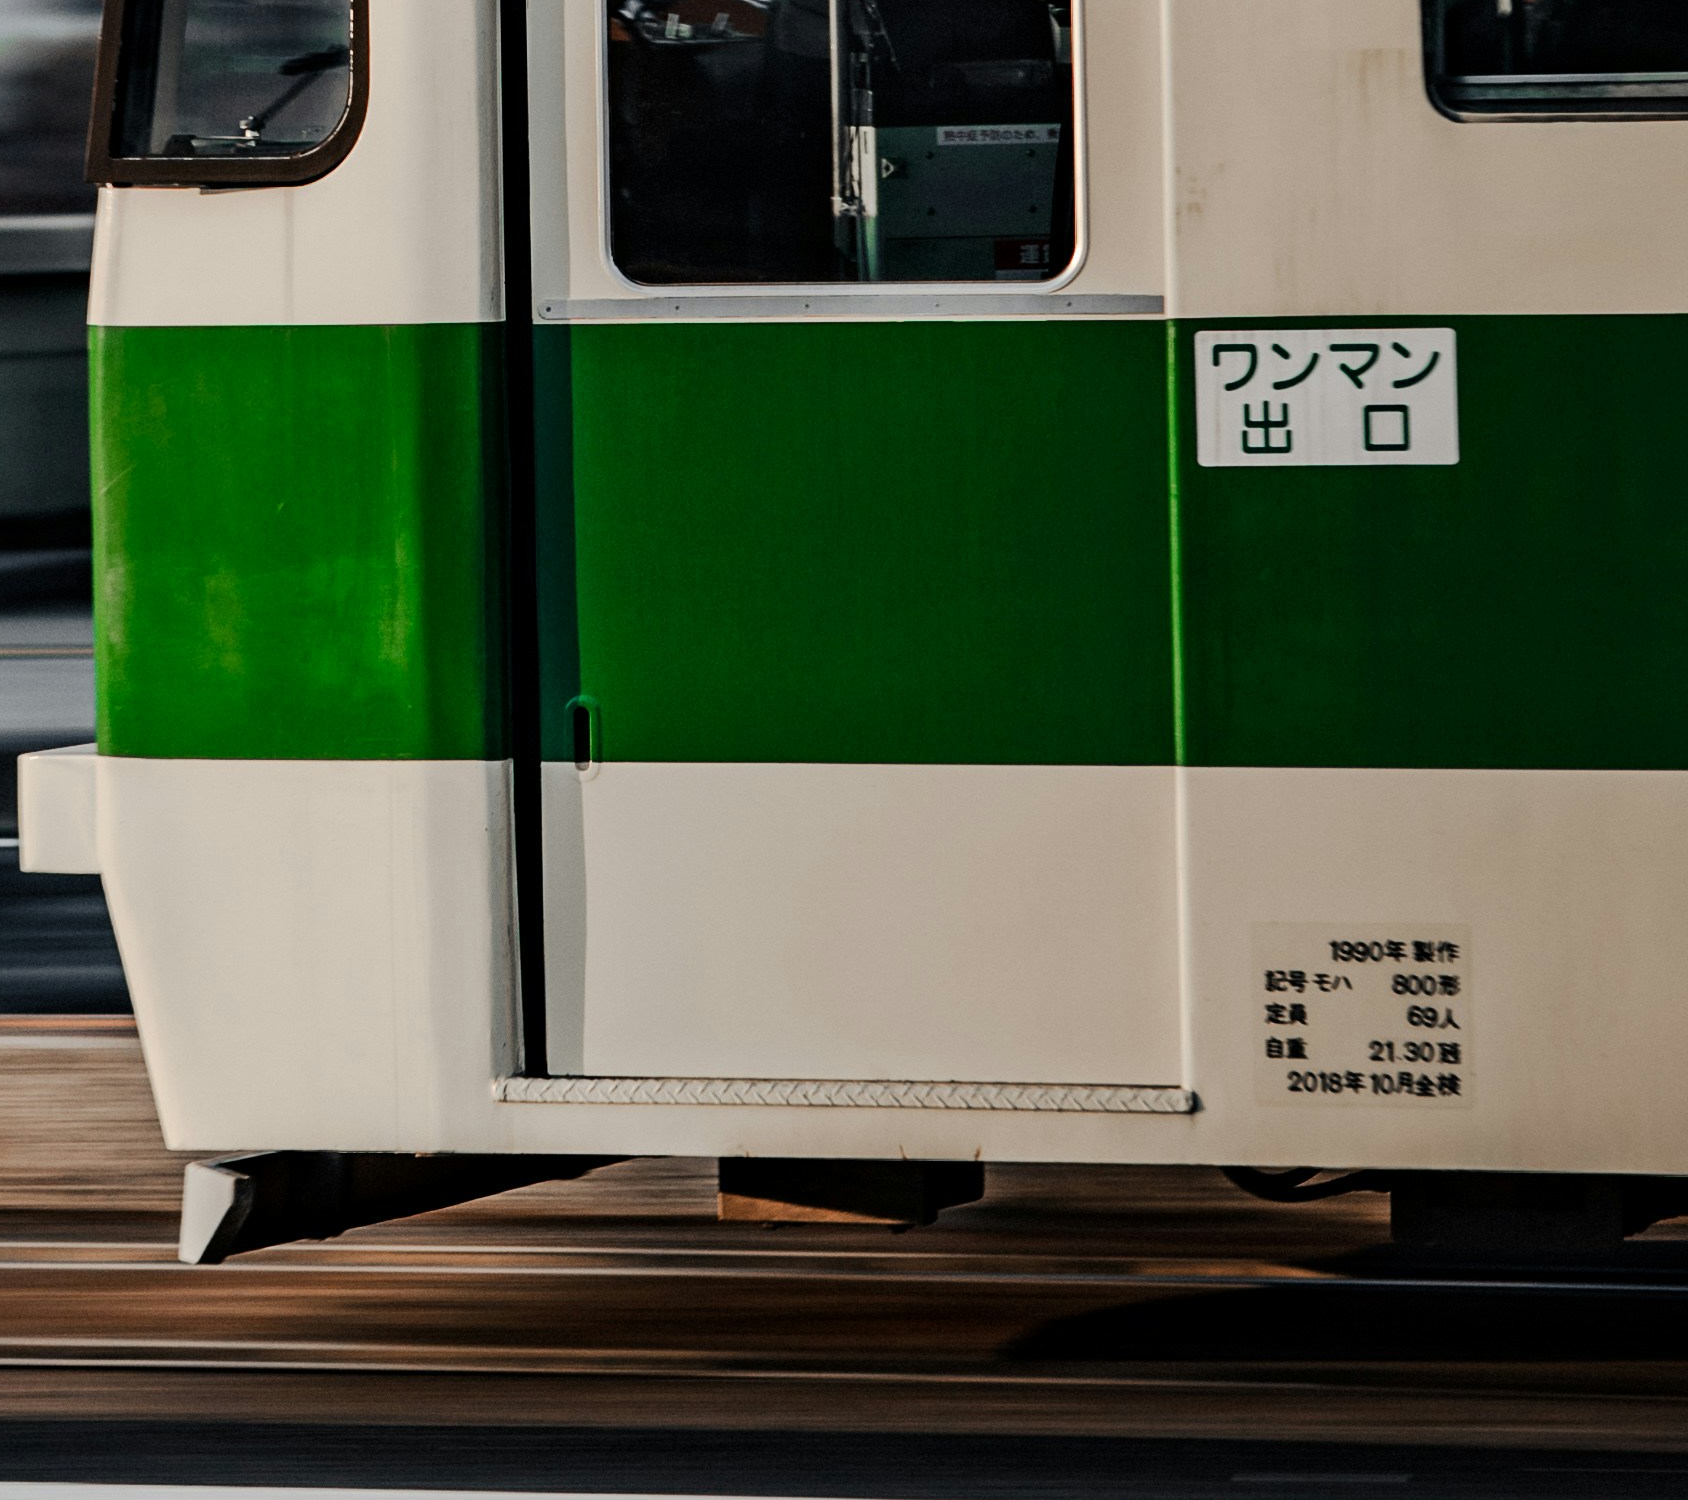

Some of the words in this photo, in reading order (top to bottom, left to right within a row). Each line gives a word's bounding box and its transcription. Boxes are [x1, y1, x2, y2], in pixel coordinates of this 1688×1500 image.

[1212, 342, 1440, 391] ワンマン
[1264, 1002, 1309, 1025] 定員
[1406, 1005, 1461, 1029] 69人
[1265, 1036, 1309, 1059] 自重
